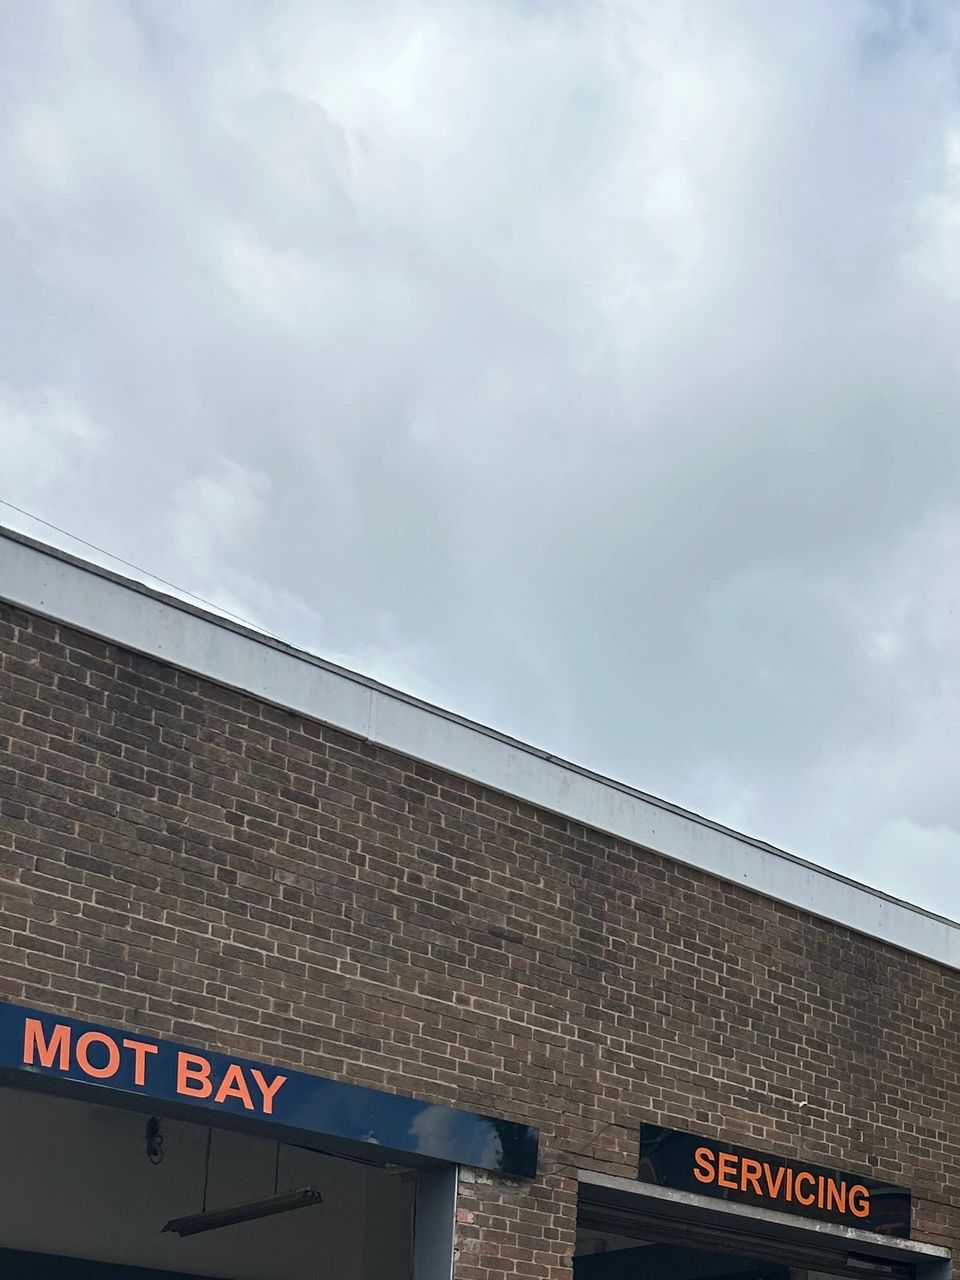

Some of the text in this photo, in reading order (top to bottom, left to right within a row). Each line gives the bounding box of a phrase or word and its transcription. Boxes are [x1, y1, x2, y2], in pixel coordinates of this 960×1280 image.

[23, 1017, 288, 1115] MOT BAY
[693, 1147, 870, 1218] SERVICING
